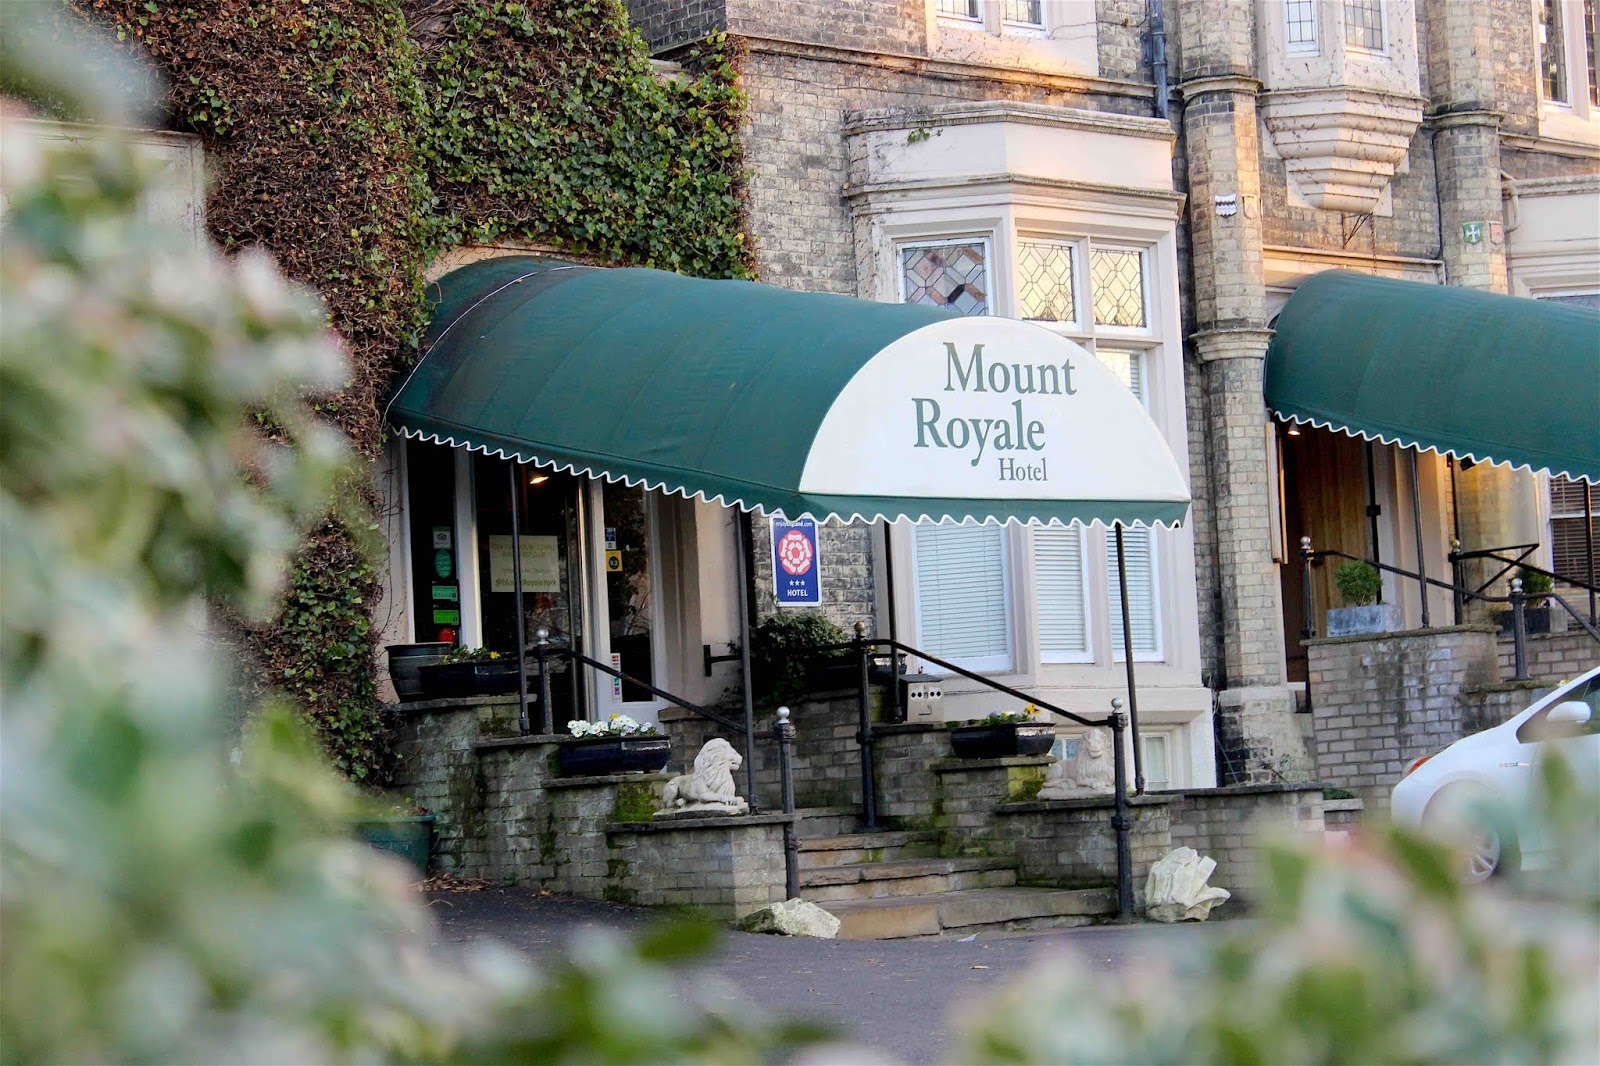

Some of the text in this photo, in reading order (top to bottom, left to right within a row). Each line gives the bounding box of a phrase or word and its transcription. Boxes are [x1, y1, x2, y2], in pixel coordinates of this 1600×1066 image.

[943, 342, 1077, 395] Mount
[911, 397, 1046, 467] Royale
[998, 457, 1048, 481] Hotel
[787, 589, 808, 597] HOTEL
